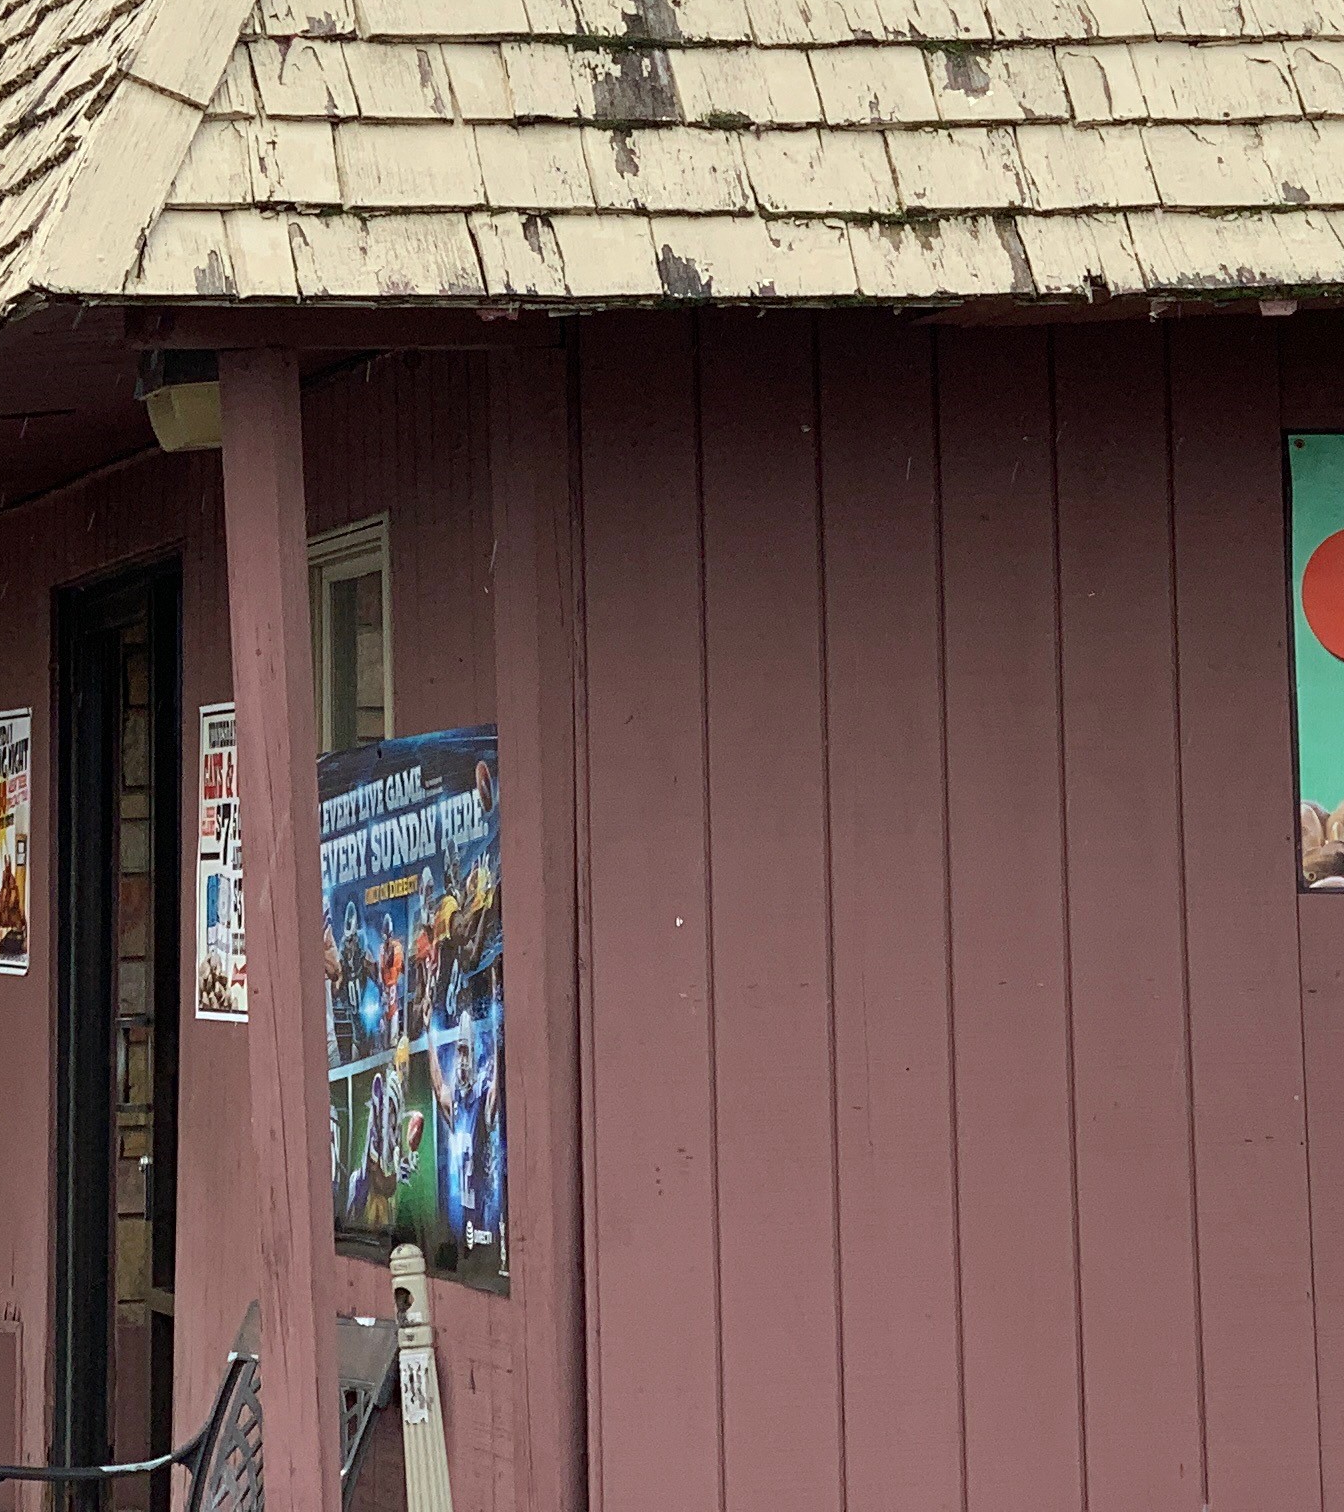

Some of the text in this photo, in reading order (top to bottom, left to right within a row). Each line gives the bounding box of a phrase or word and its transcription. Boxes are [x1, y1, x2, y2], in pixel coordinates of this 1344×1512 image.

[322, 790, 356, 835] EVERY
[356, 778, 385, 821] LIVE
[320, 829, 368, 887] EVERY
[370, 804, 437, 874] SUNDAY
